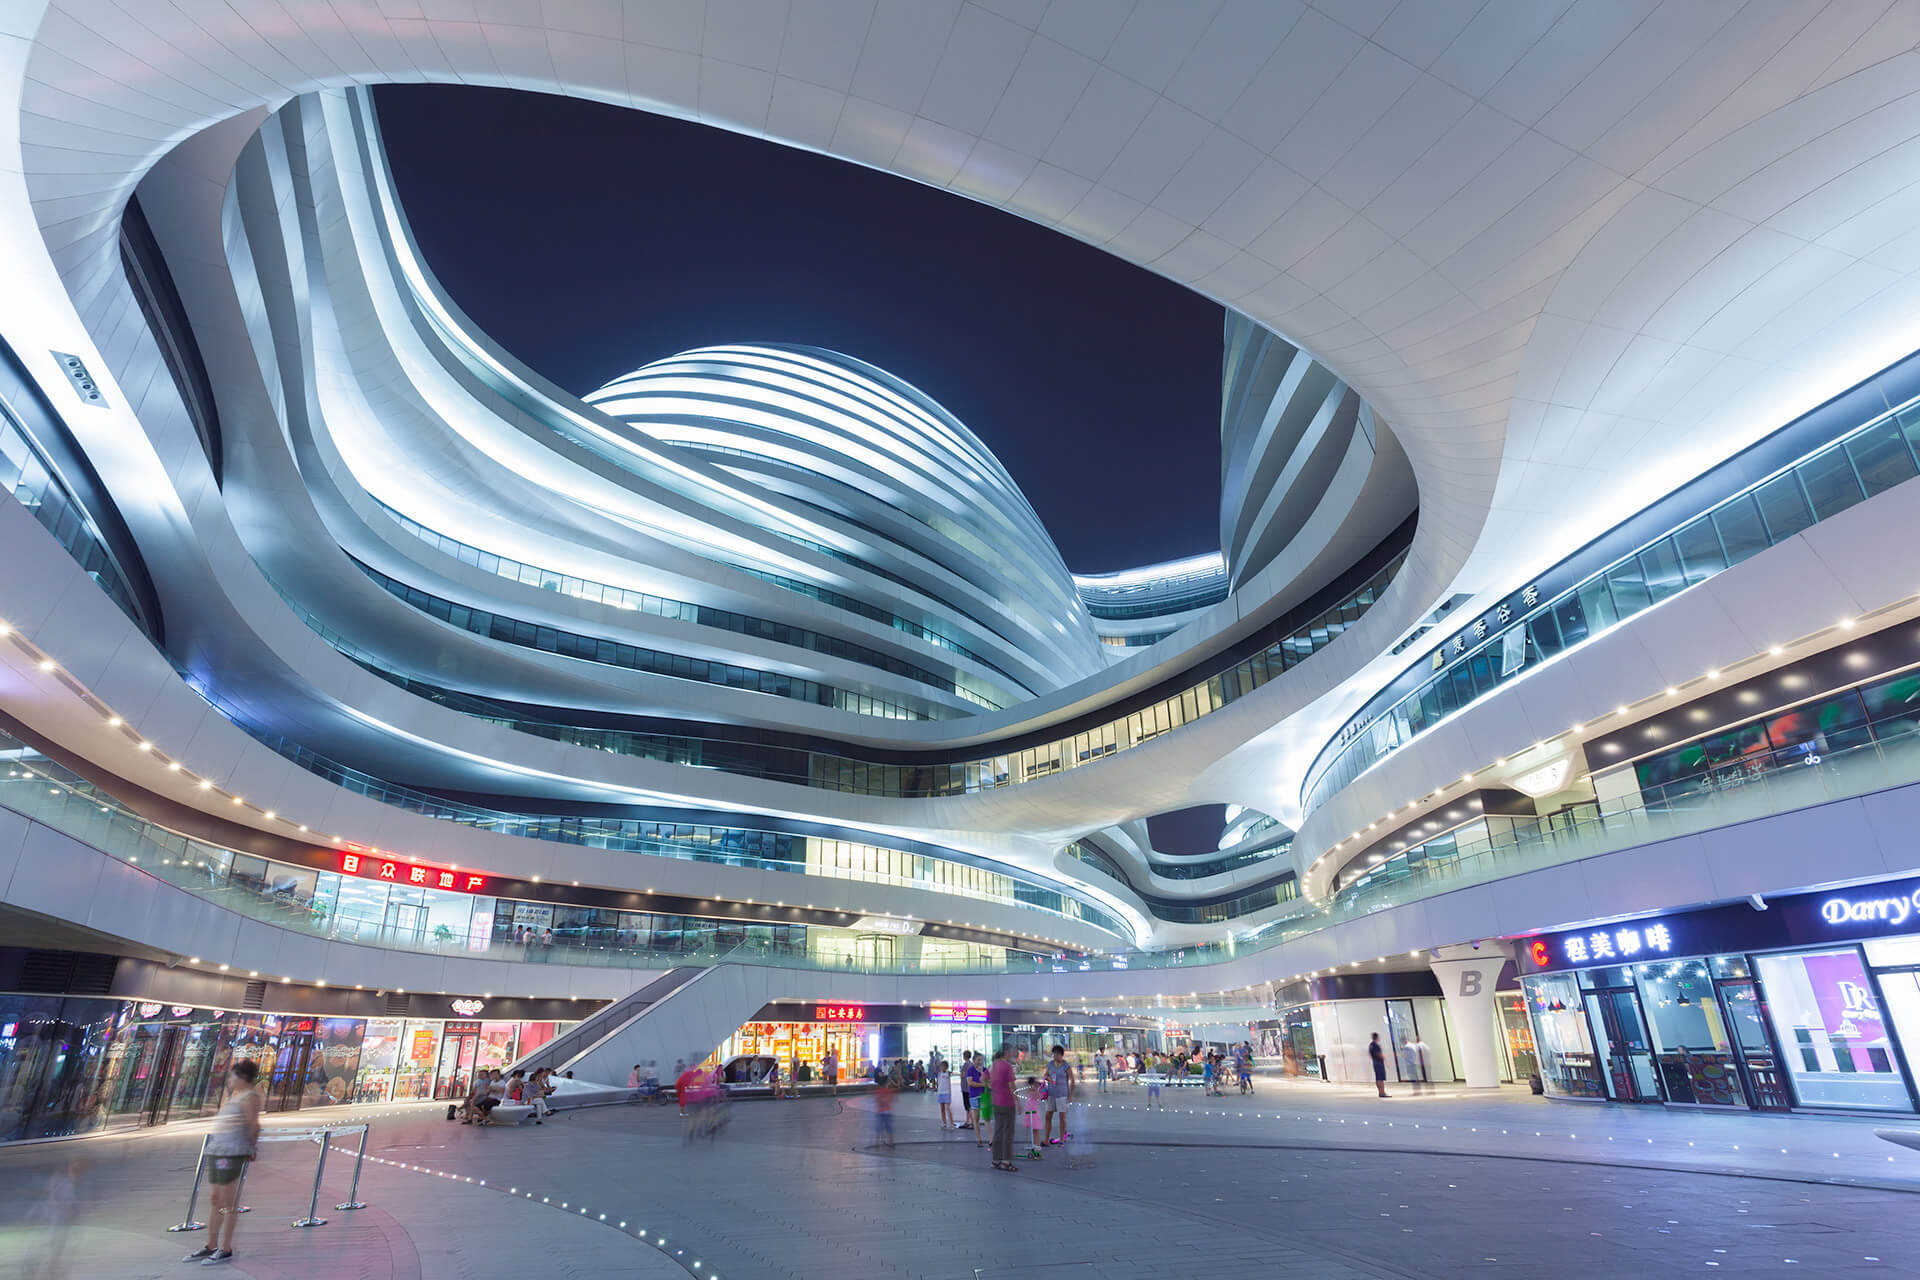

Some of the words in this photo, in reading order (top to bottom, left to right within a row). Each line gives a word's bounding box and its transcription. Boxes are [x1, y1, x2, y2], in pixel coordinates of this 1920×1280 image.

[380, 862, 483, 890] 众联地产
[1822, 896, 1910, 924] Darry
[1459, 970, 1482, 997] B
[1837, 981, 1876, 1011] DR
